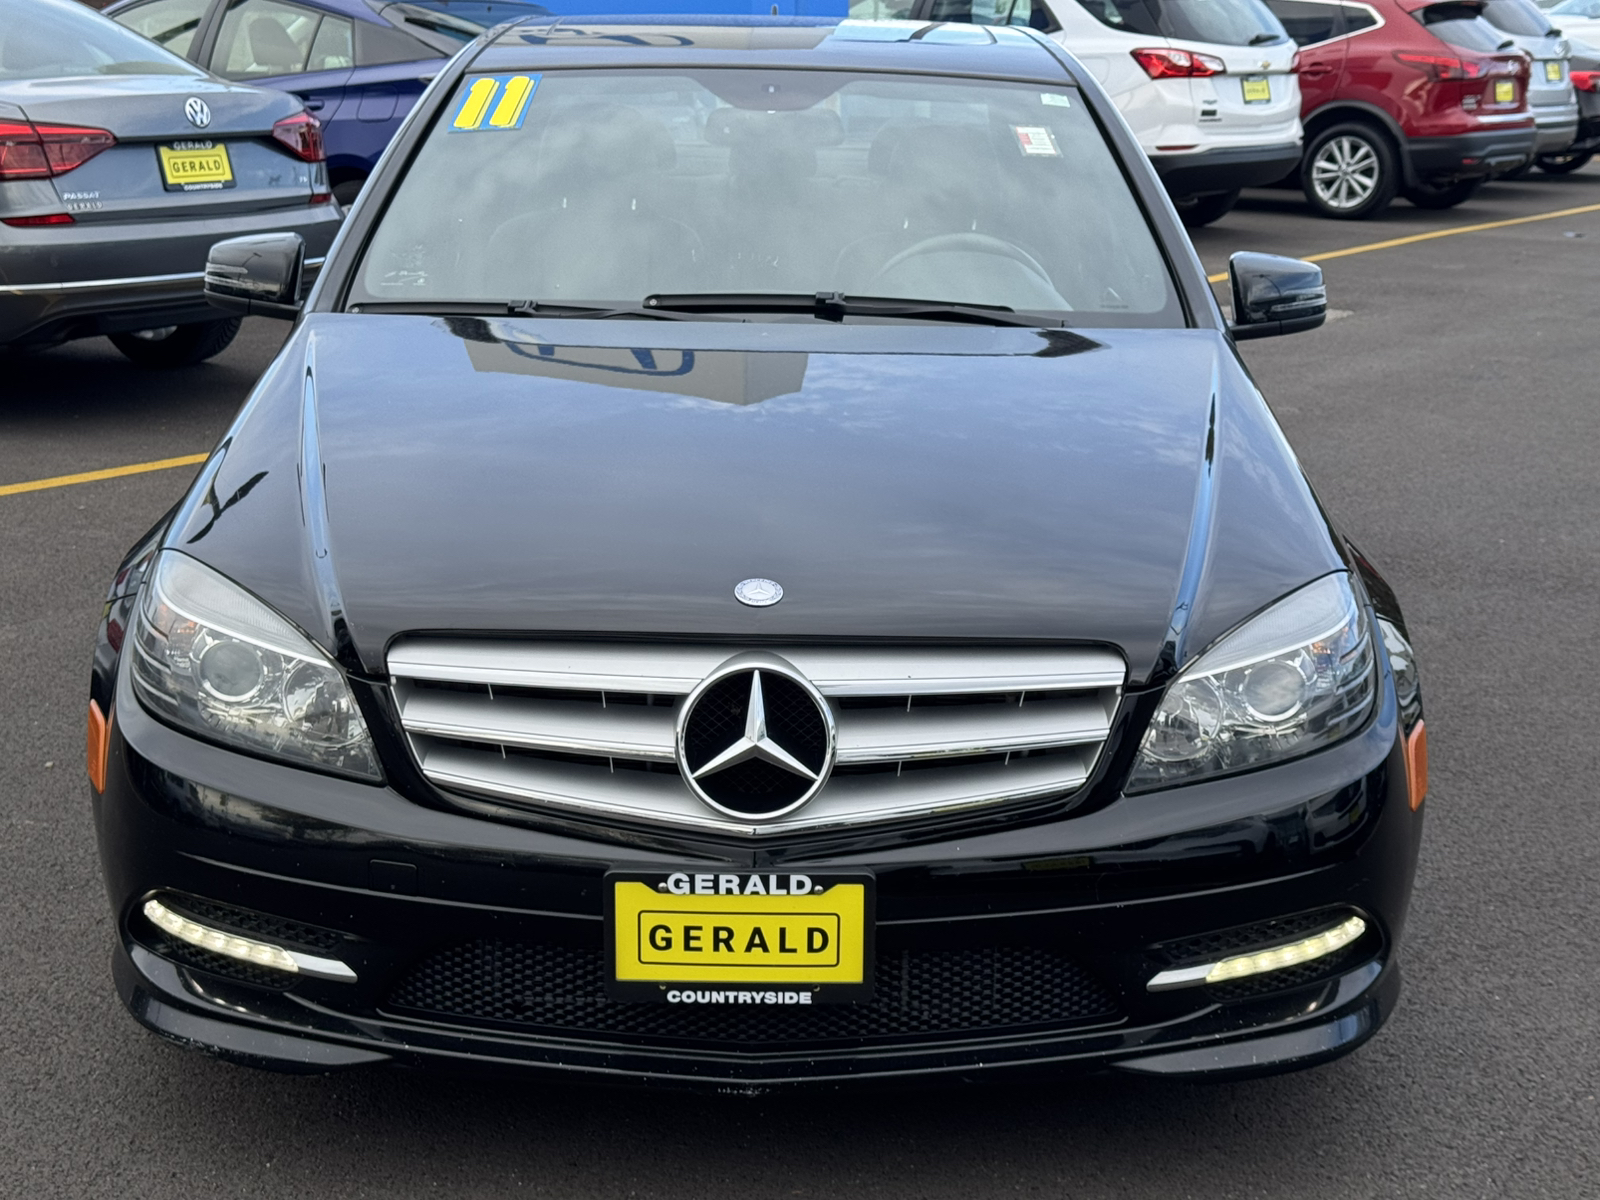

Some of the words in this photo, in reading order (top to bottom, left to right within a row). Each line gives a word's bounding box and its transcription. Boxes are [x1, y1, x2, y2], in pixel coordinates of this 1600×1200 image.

[453, 75, 535, 130] 11
[173, 140, 213, 150] GERALD
[172, 159, 221, 173] GERALD
[63, 191, 101, 200] PASSAT
[667, 873, 812, 895] GERALD
[648, 924, 830, 954] GERALD
[667, 990, 812, 1004] COUNTRYSIDE
